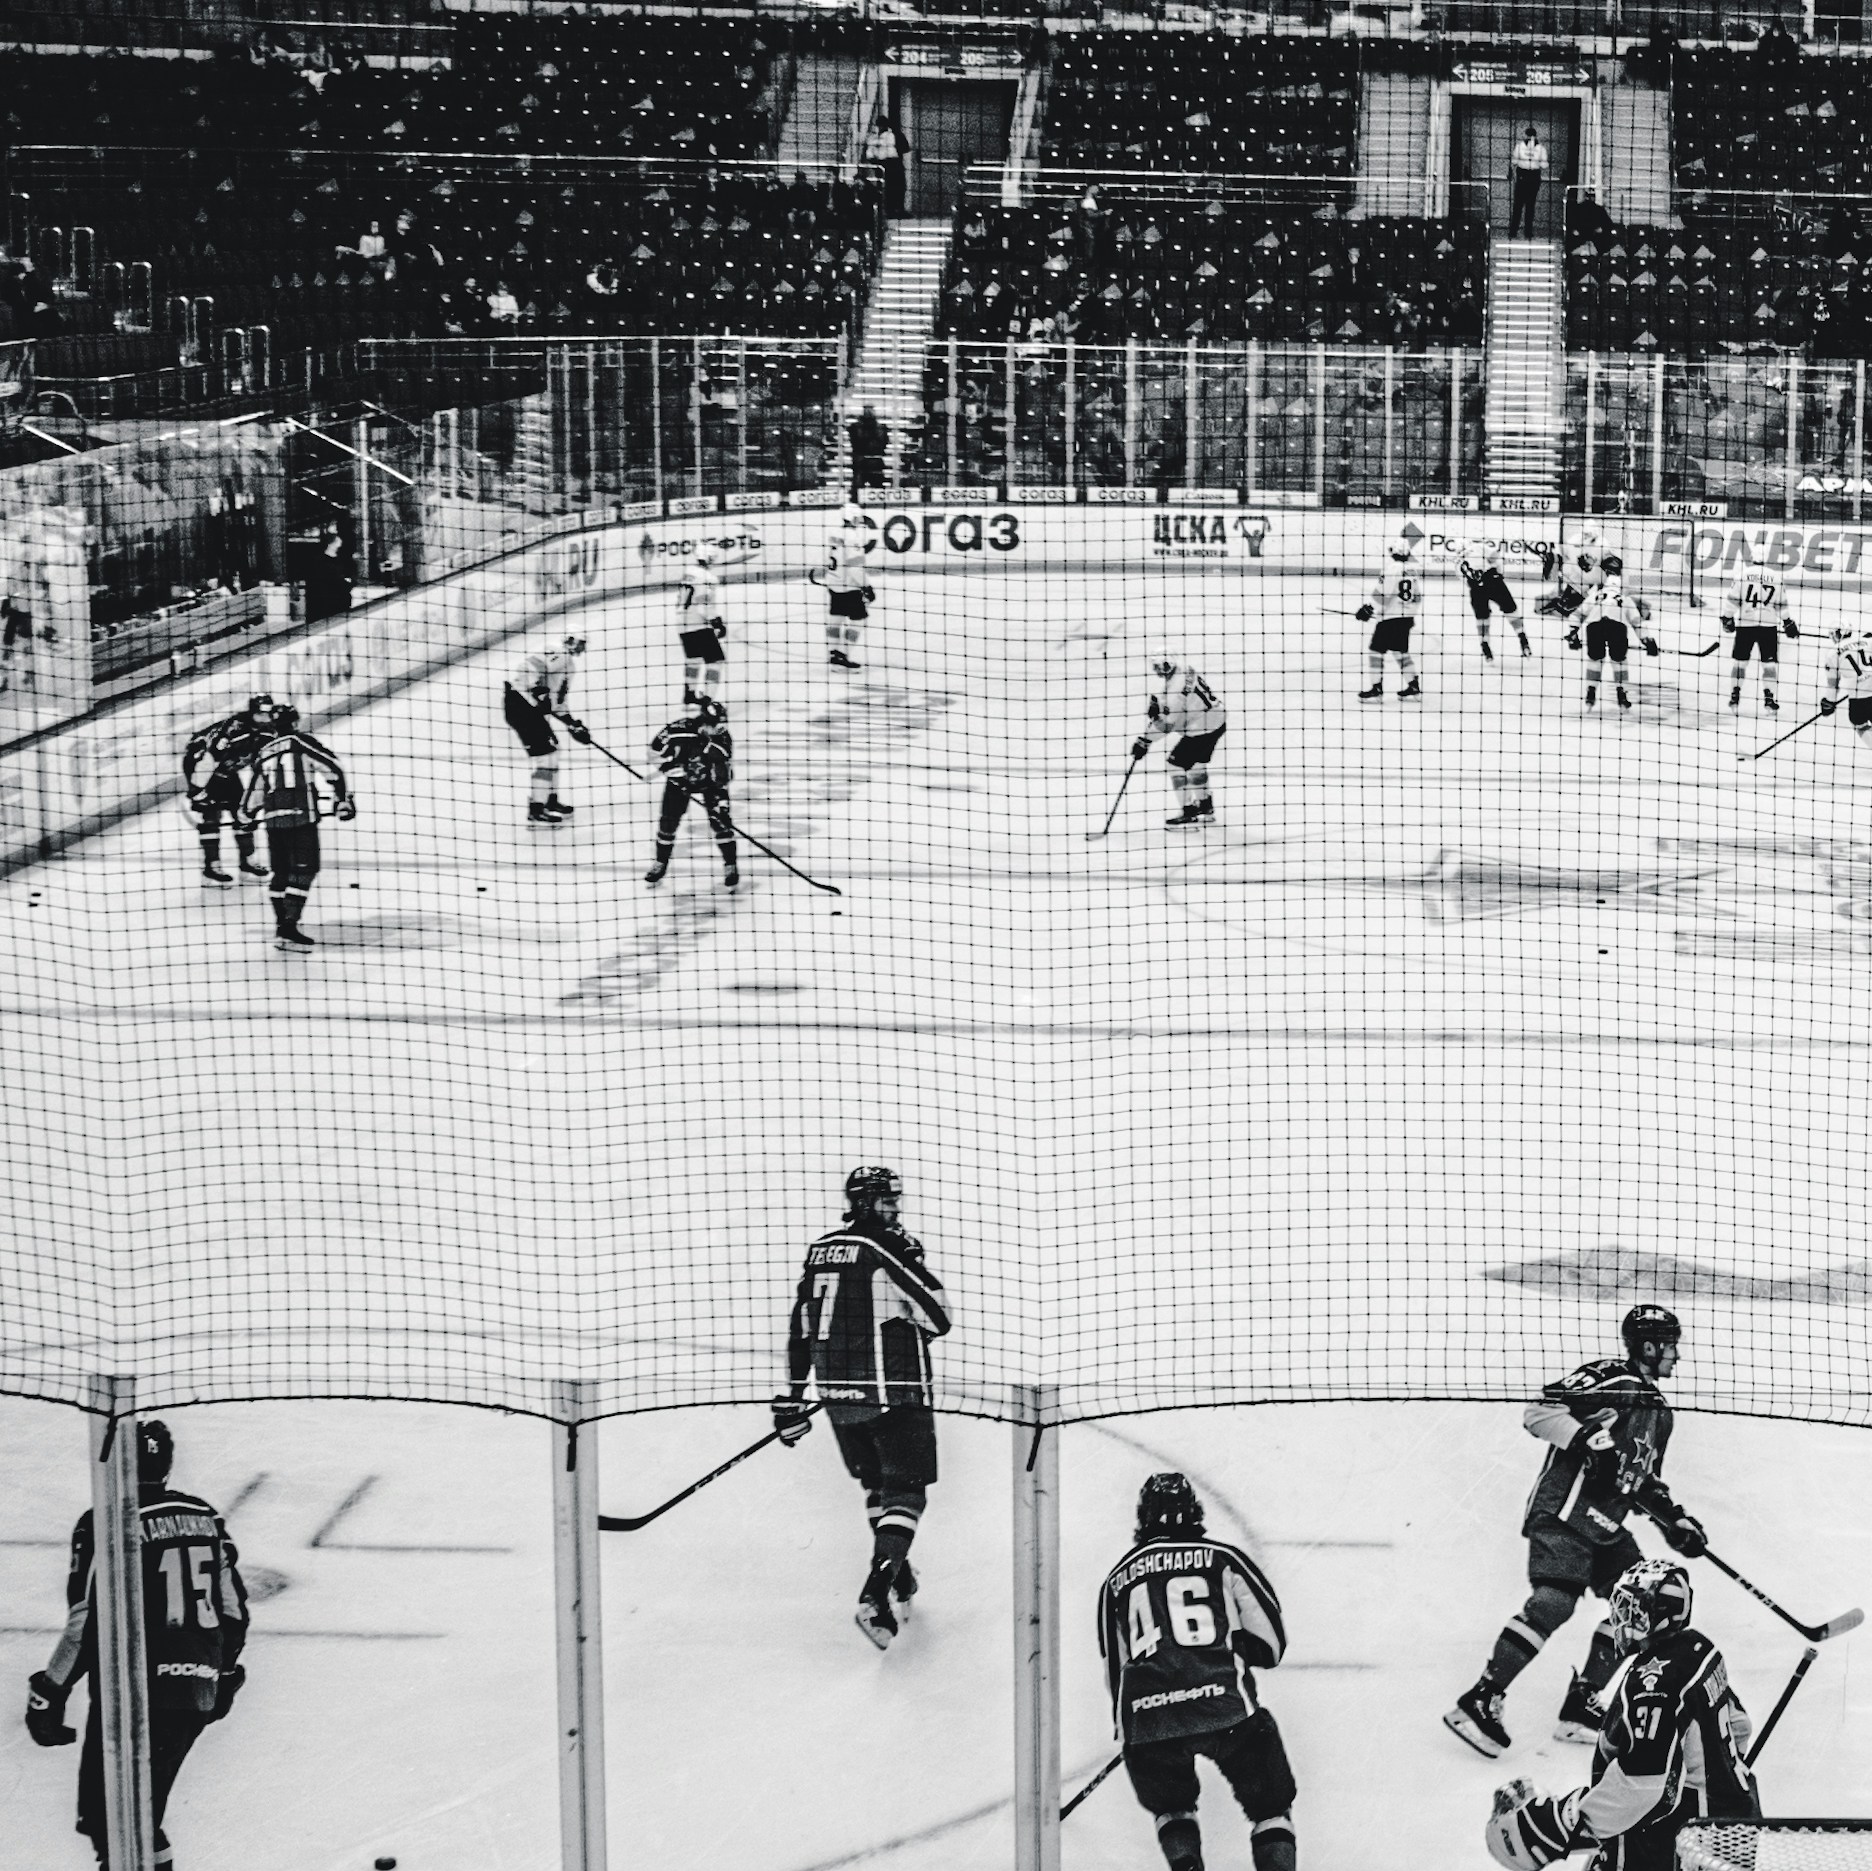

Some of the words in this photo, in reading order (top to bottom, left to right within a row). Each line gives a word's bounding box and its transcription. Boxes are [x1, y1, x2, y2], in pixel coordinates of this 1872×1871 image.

[1418, 497, 1470, 509] KHL.RU
[1499, 499, 1551, 511] KHL.RU
[1667, 504, 1719, 516] KHL.RU
[1153, 514, 1227, 546] ЦСКА
[1745, 583, 1776, 608] 47
[812, 1271, 841, 1341] 7
[158, 1545, 221, 1629] 15
[1128, 1575, 1217, 1661] 46
[1131, 1683, 1225, 1713] РОСНЕФТЬ
[1634, 1705, 1662, 1740] 31
